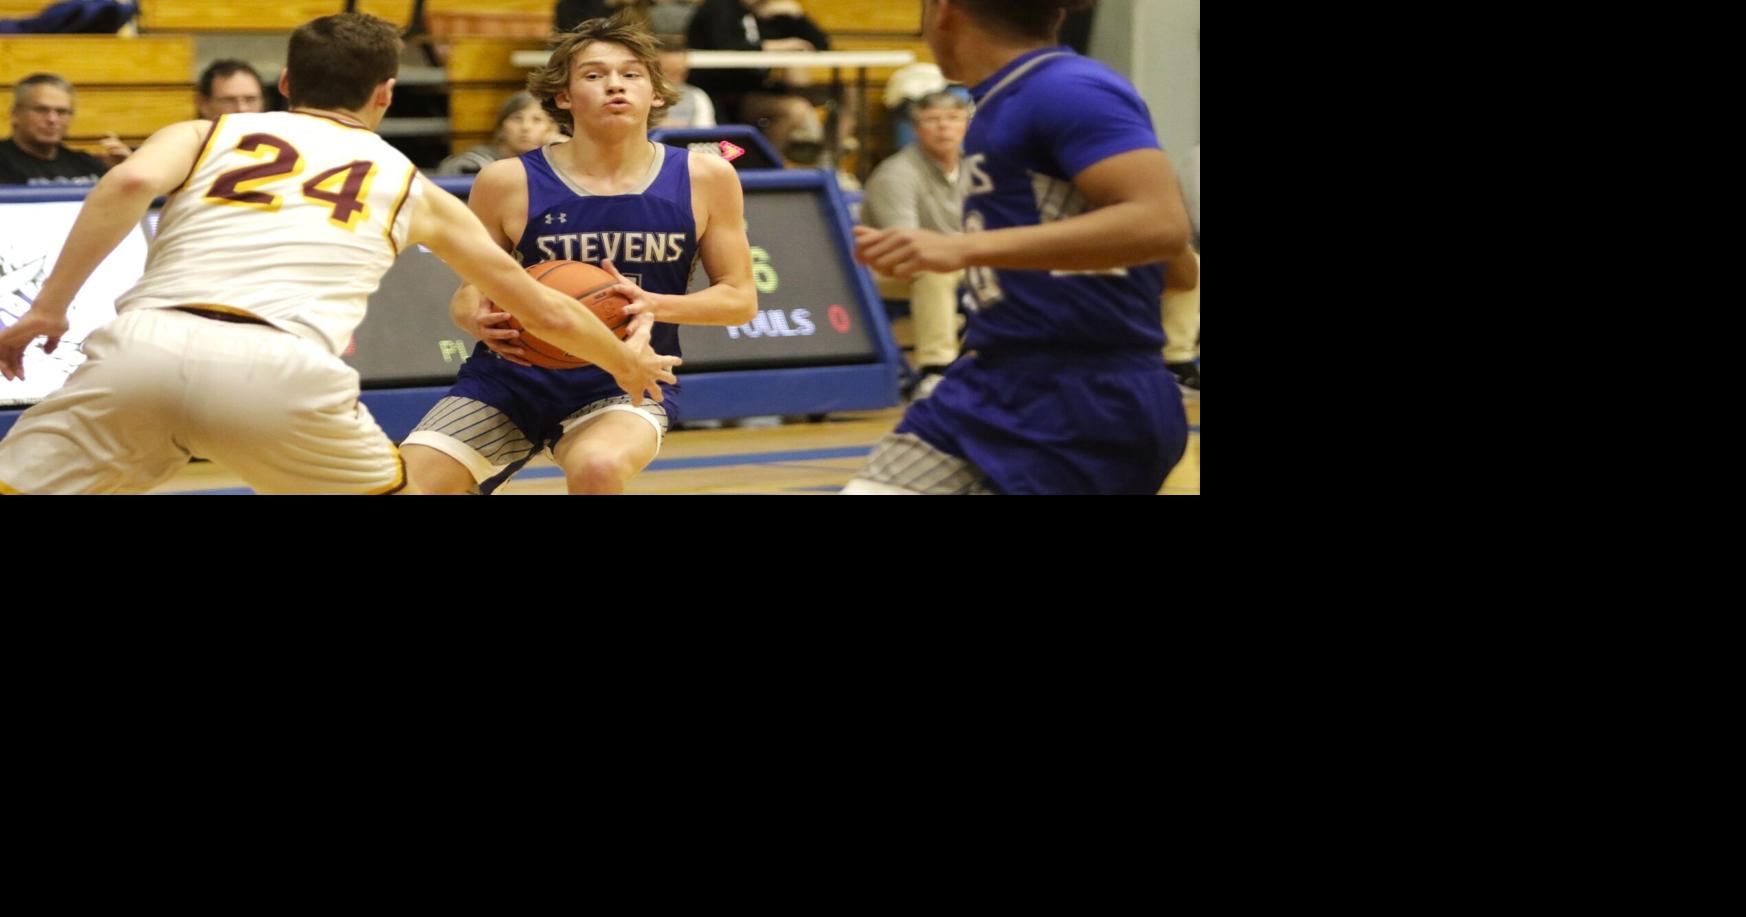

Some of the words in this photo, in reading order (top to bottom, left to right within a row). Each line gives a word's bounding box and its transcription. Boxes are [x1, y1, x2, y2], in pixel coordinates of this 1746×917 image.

[205, 132, 378, 232] 24
[536, 231, 686, 263] STEVENS
[827, 303, 850, 334] 0
